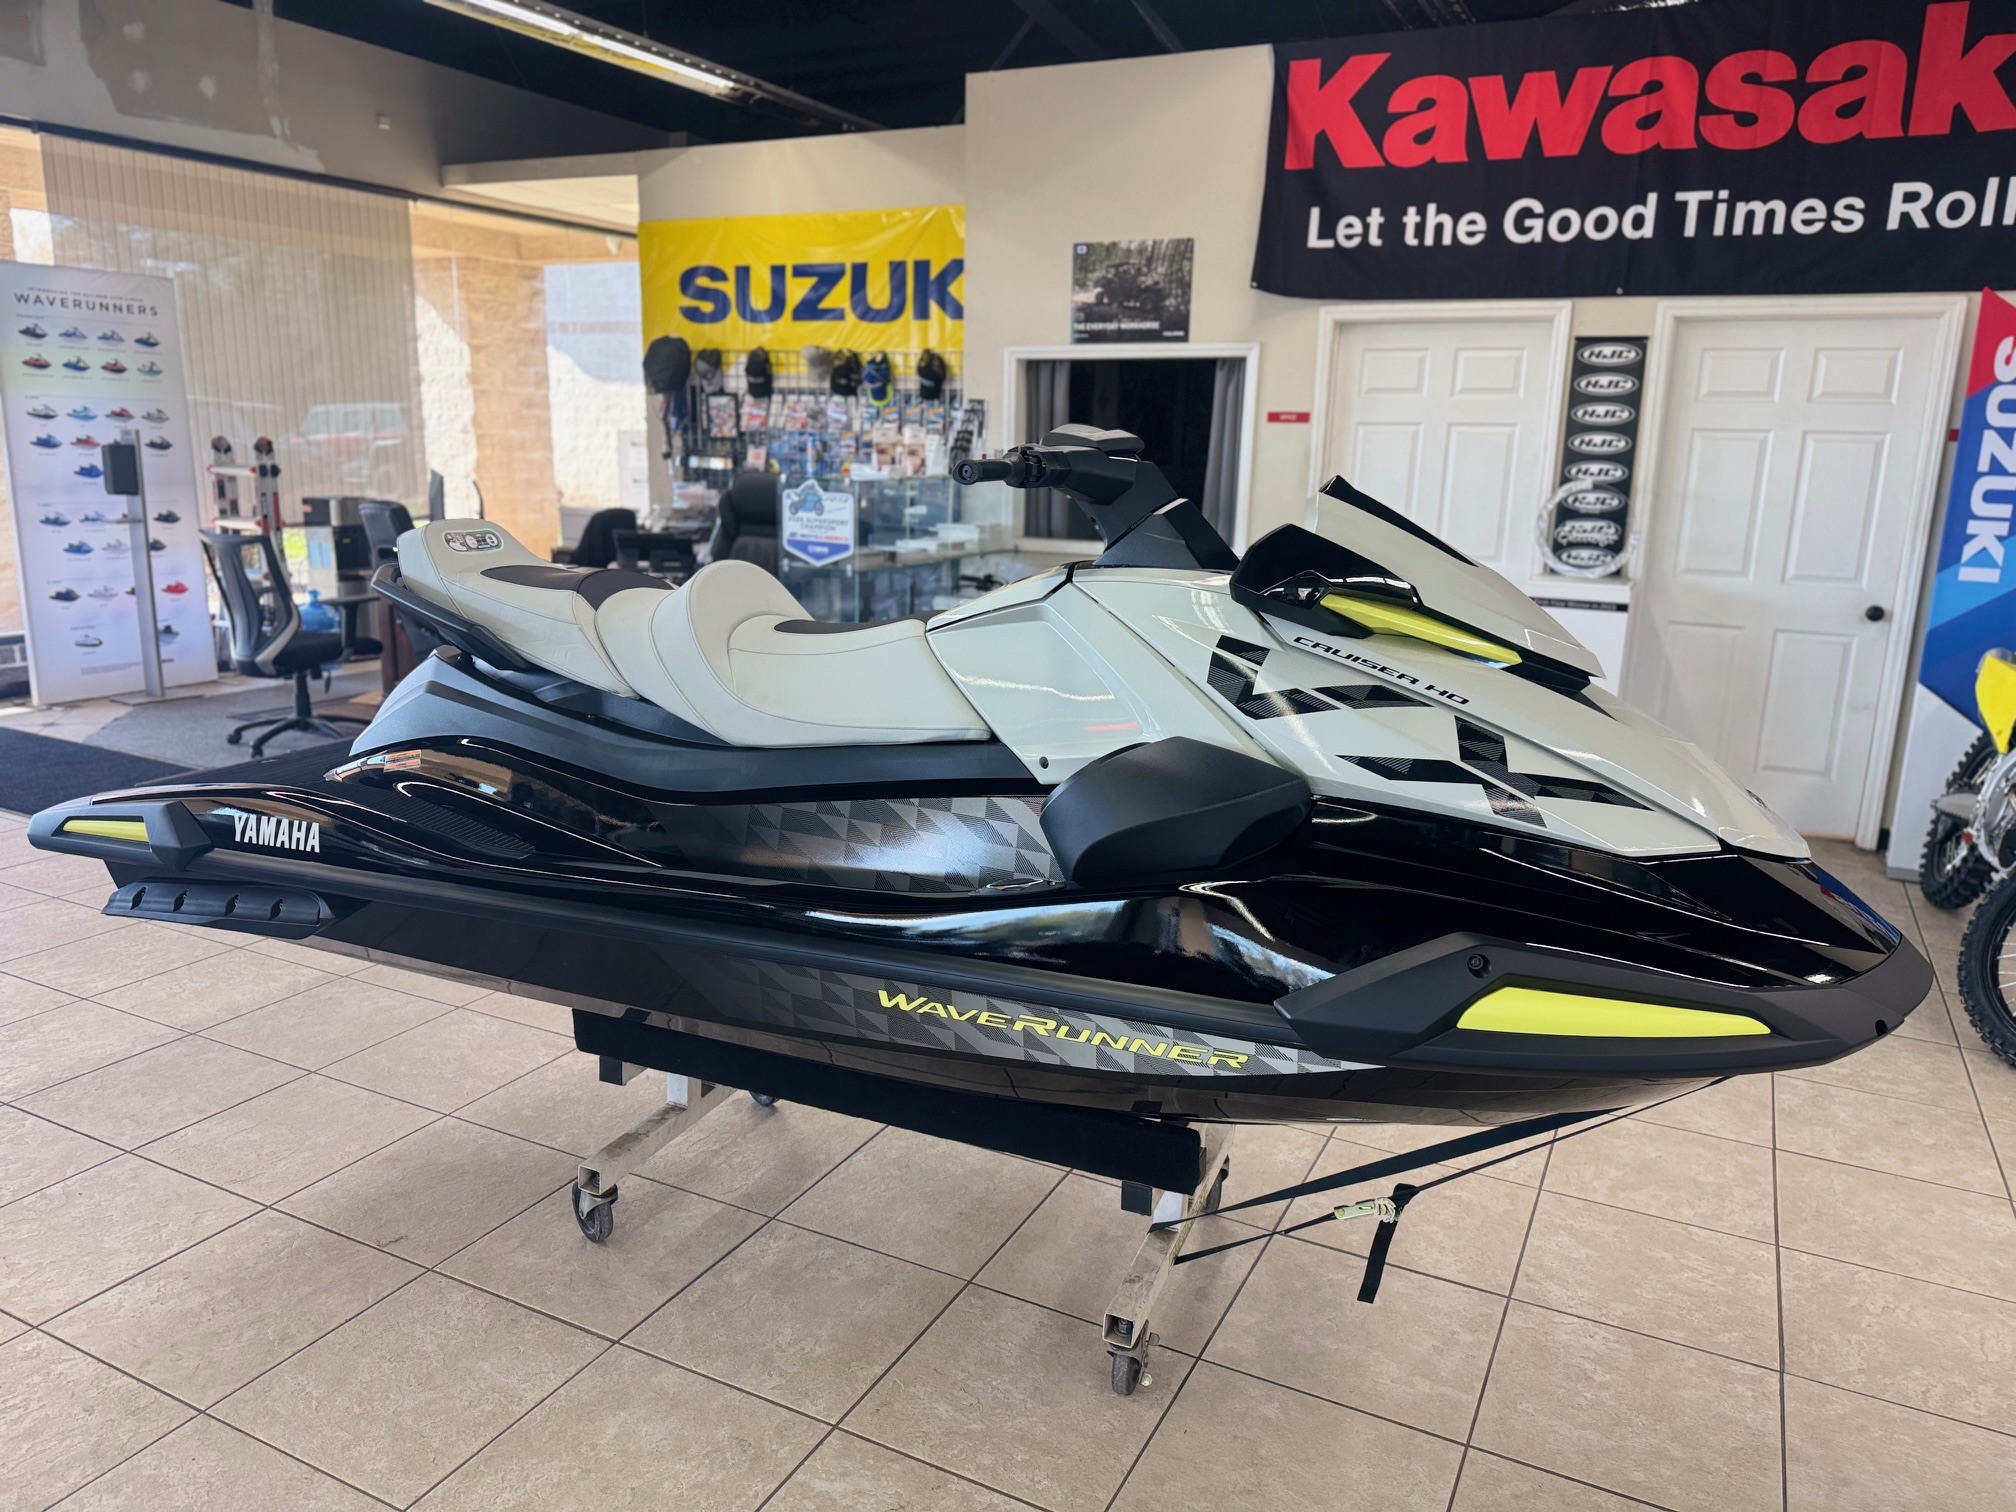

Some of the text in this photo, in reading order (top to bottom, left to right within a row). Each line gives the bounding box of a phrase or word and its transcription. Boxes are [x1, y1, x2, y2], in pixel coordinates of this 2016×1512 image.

[1306, 176, 2016, 249] Let the Good Times Roll
[14, 292, 159, 316] WAVERUNNERS
[1588, 349, 1632, 359] HJC
[1585, 379, 1629, 389] HJC
[1581, 409, 1625, 419] HJC
[1578, 438, 1622, 448] HJC
[1574, 467, 1618, 477] HJC
[1292, 636, 1470, 707] CRUISER HO
[233, 812, 321, 853] YAMAHA
[877, 989, 1249, 1070] WAVERUNNER
